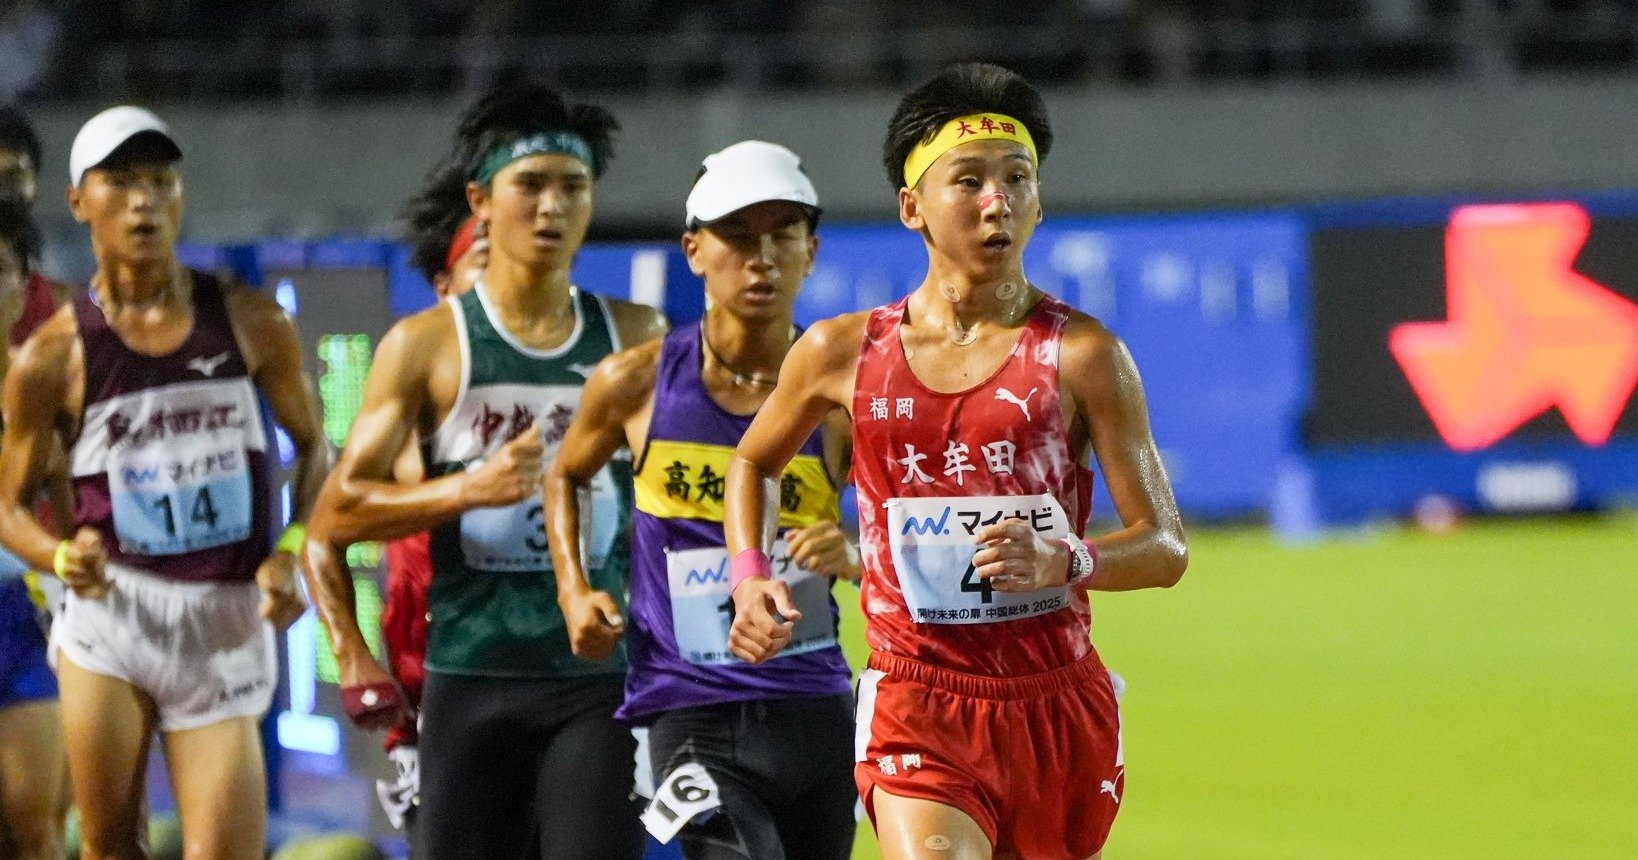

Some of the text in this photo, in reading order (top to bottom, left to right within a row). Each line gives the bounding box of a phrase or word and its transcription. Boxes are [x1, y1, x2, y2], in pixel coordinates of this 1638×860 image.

[956, 116, 1016, 139] 大牟田
[869, 396, 915, 421] 福岡
[664, 460, 802, 512] 高知高
[897, 439, 1017, 487] 大牟田
[154, 485, 218, 538] 14
[985, 604, 1030, 618] 中国総体
[1032, 596, 1061, 613] 2025
[655, 774, 711, 825] 16
